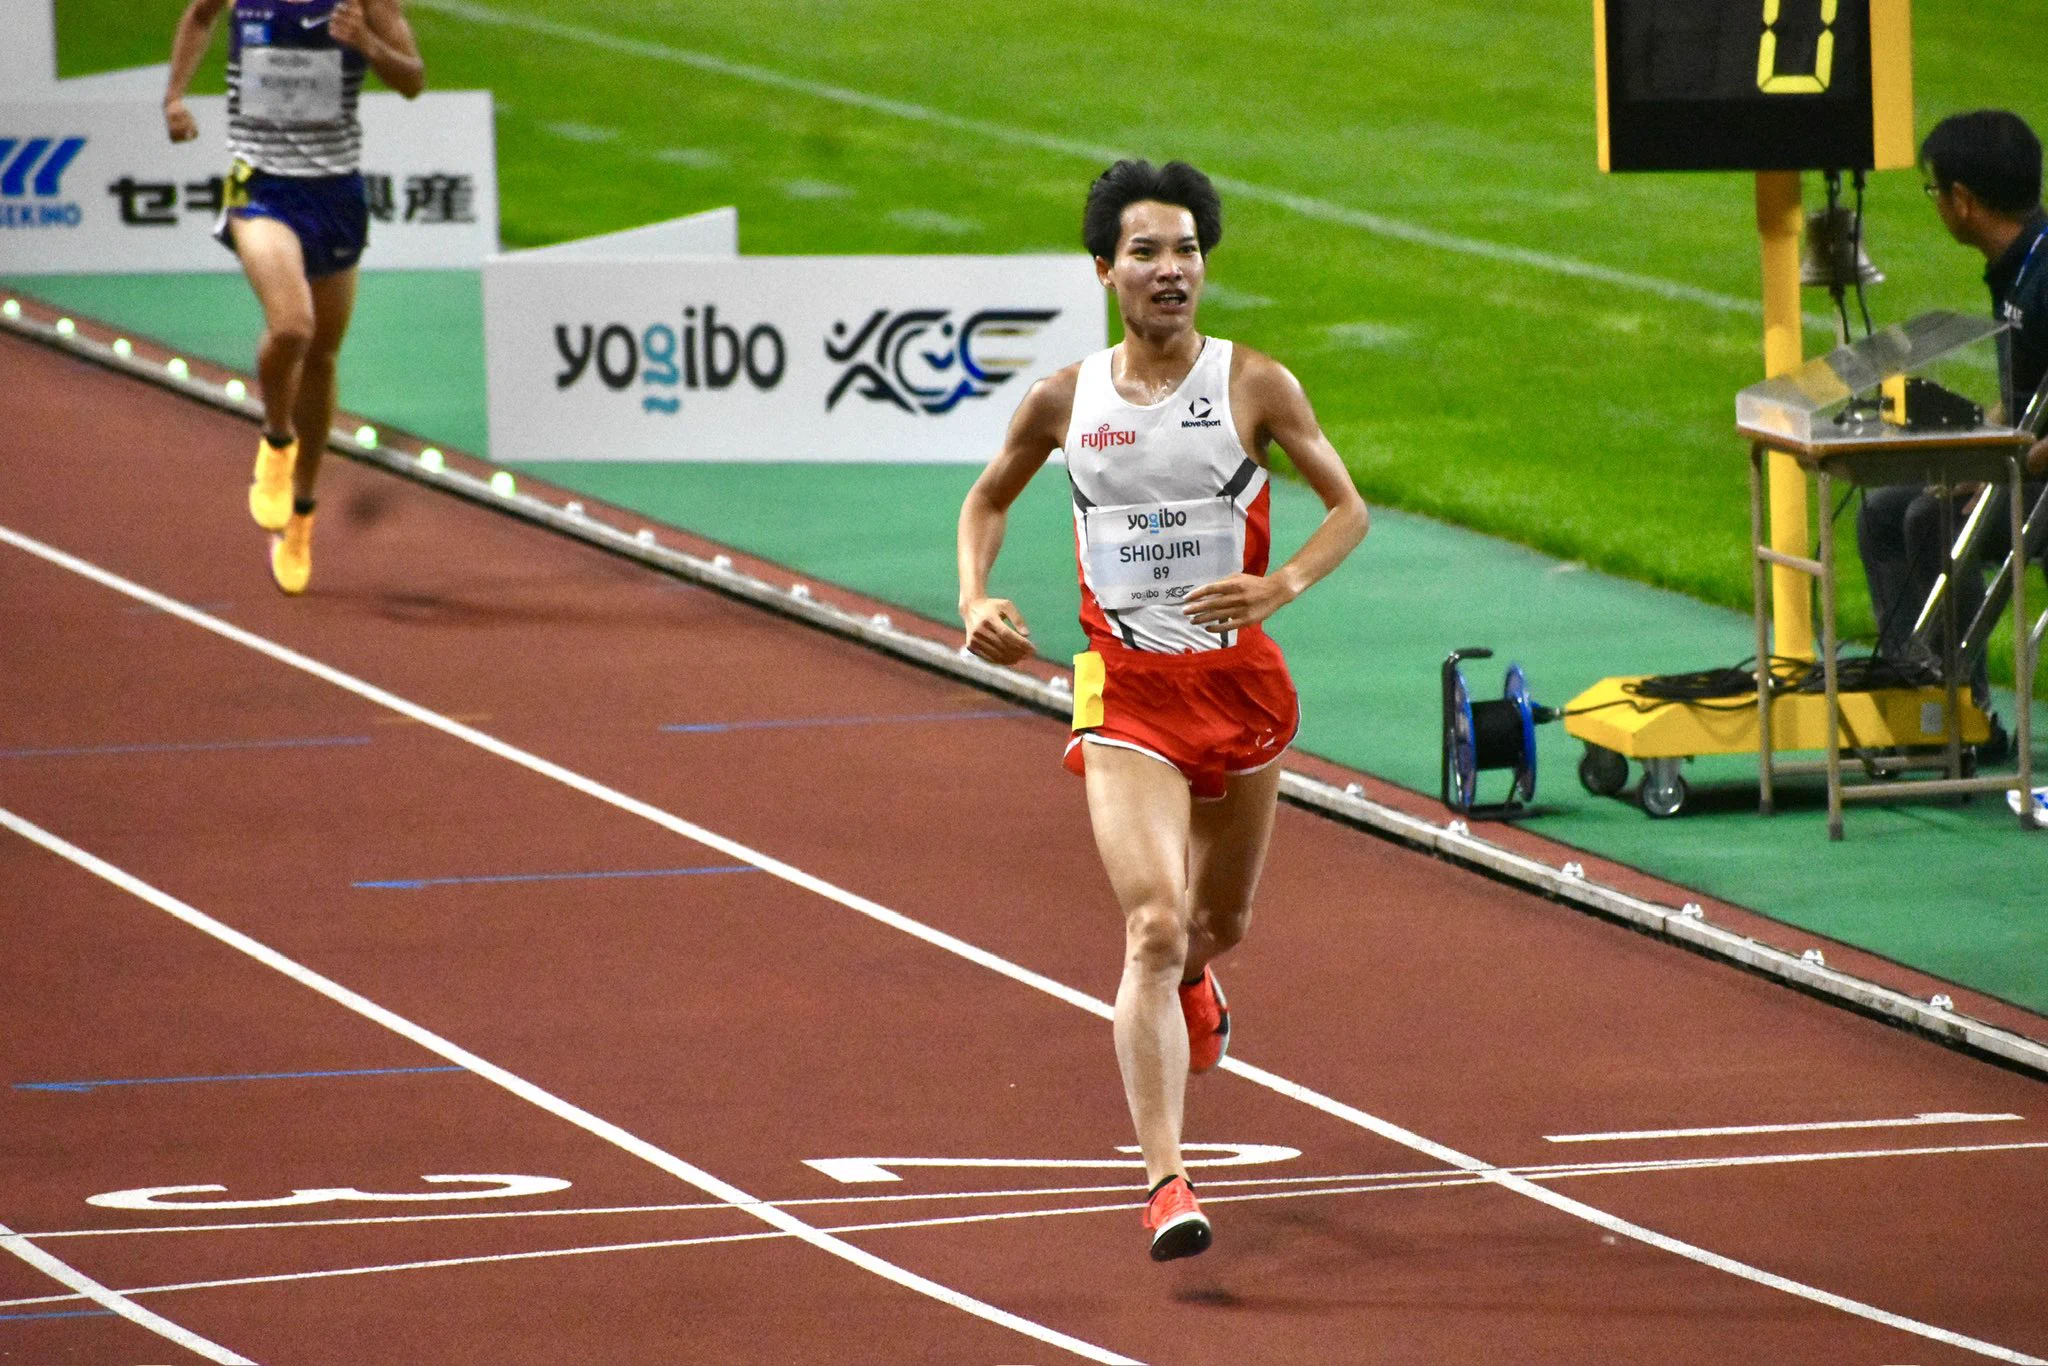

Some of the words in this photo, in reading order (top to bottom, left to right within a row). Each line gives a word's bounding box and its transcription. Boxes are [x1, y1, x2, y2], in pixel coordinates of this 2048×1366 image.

[554, 305, 786, 414] yogibo
[1081, 423, 1136, 451] FUJITSU
[1181, 419, 1221, 428] MoveSport
[1127, 508, 1187, 534] yogibo
[1120, 540, 1201, 563] SHIOJIRI
[1153, 566, 1170, 580] 89
[800, 1142, 1303, 1184] 2
[84, 1173, 573, 1211] 3
